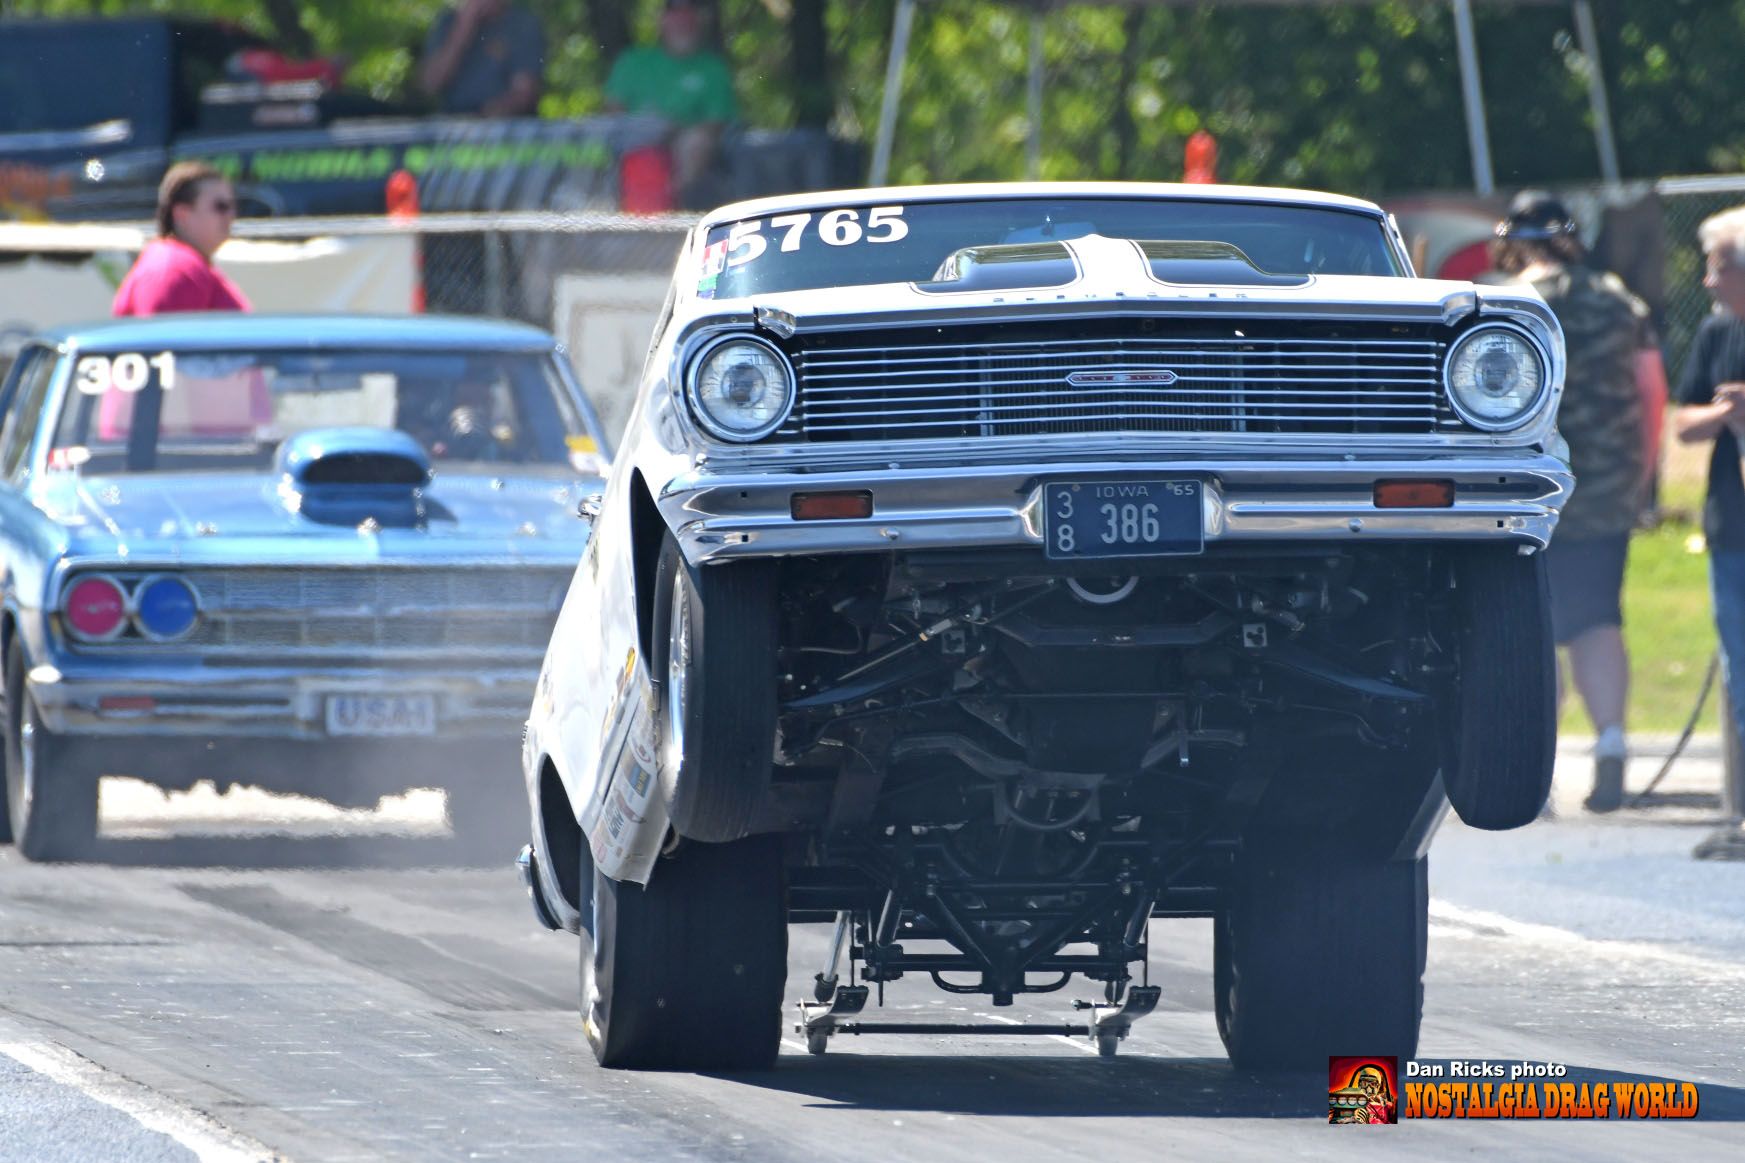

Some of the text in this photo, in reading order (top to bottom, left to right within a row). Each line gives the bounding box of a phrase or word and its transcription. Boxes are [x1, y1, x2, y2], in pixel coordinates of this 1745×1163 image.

[727, 205, 909, 267] 5765
[76, 350, 175, 394] 301
[1096, 484, 1194, 498] IOWA 65
[1100, 503, 1160, 544] 386
